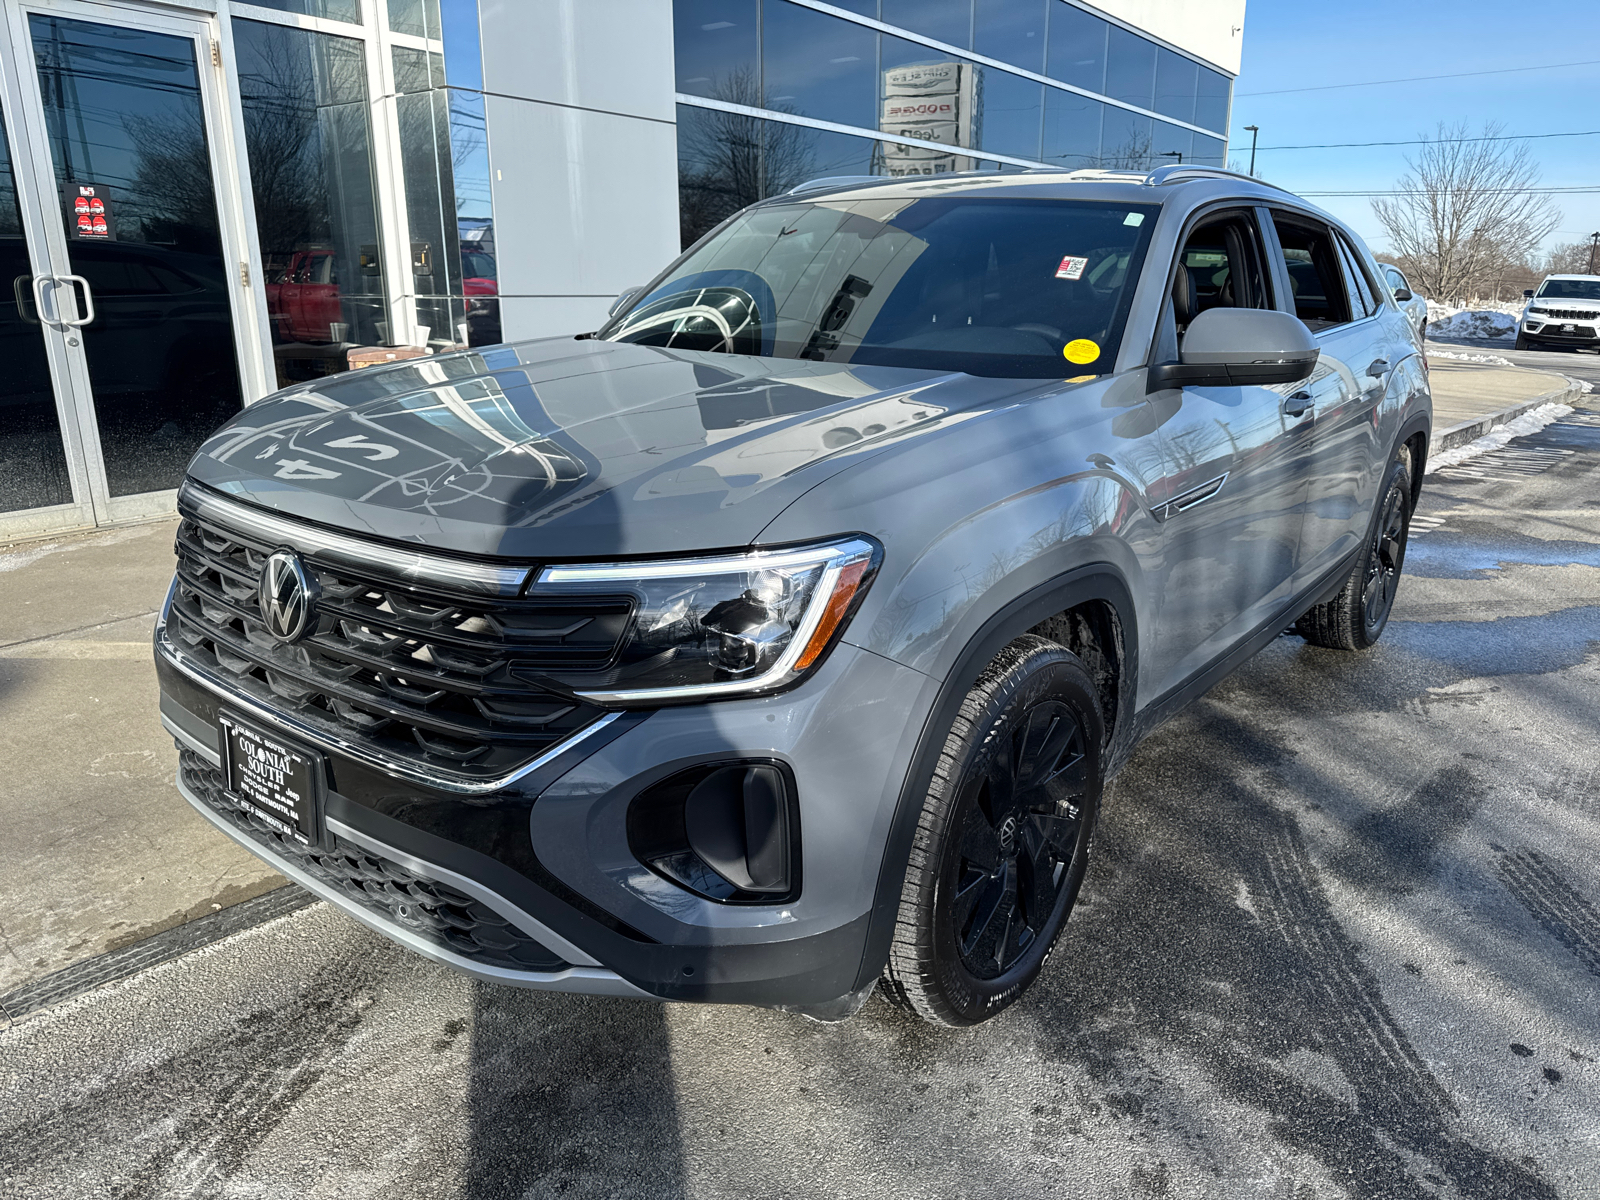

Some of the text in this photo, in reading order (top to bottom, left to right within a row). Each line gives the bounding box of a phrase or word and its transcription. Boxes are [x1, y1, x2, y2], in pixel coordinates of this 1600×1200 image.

[239, 736, 293, 776] COLONIAL
[247, 755, 285, 786] SOUTH
[238, 763, 300, 802] CHRYSLER Jeep
[243, 775, 294, 807] DODGE RAM
[289, 809, 299, 821] MA
